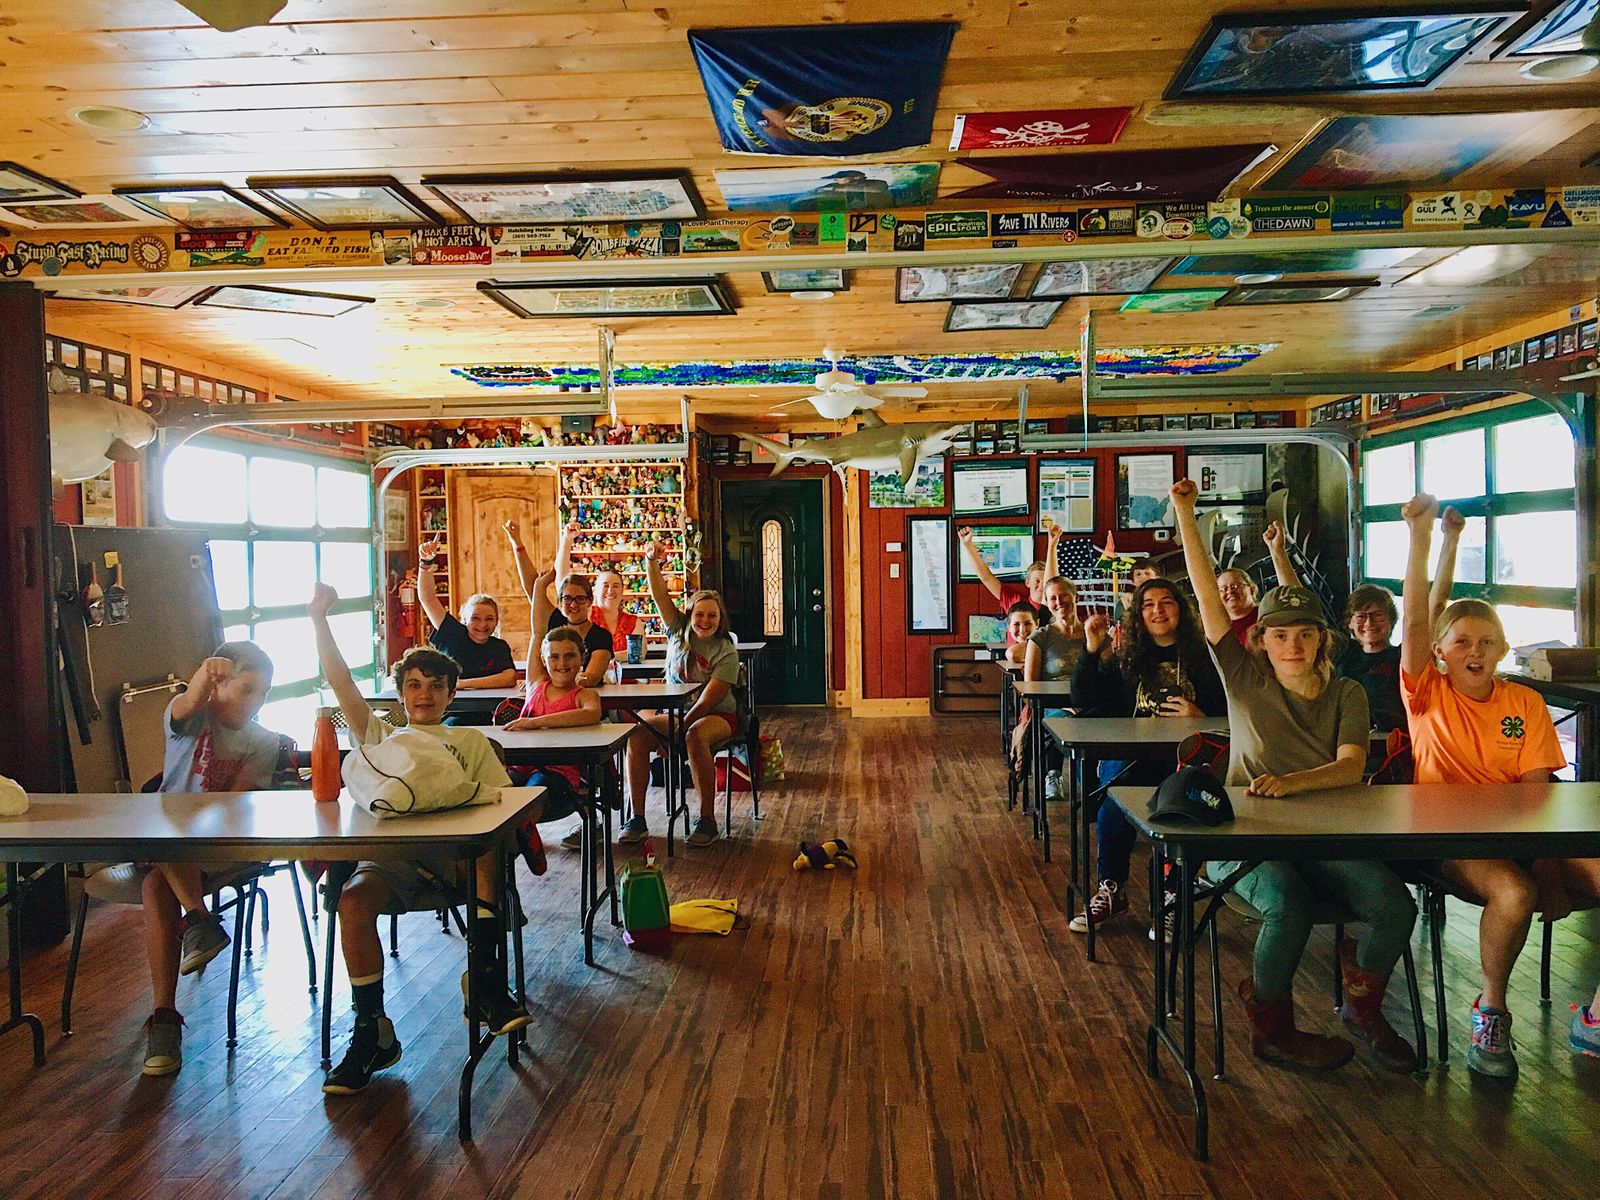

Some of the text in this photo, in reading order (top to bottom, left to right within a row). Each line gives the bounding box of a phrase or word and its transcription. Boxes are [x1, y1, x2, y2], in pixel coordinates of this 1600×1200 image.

[1417, 206, 1437, 214] GULF
[1509, 203, 1545, 213] KAVU
[999, 212, 1070, 230] SAVE TN RIVERS
[451, 225, 474, 236] FEET
[927, 223, 957, 233] EPIC
[290, 236, 337, 247] DON'T
[426, 236, 474, 247] NOT ARMS
[86, 242, 128, 266] Racing
[267, 247, 290, 256] EAT
[343, 245, 370, 254] FISH
